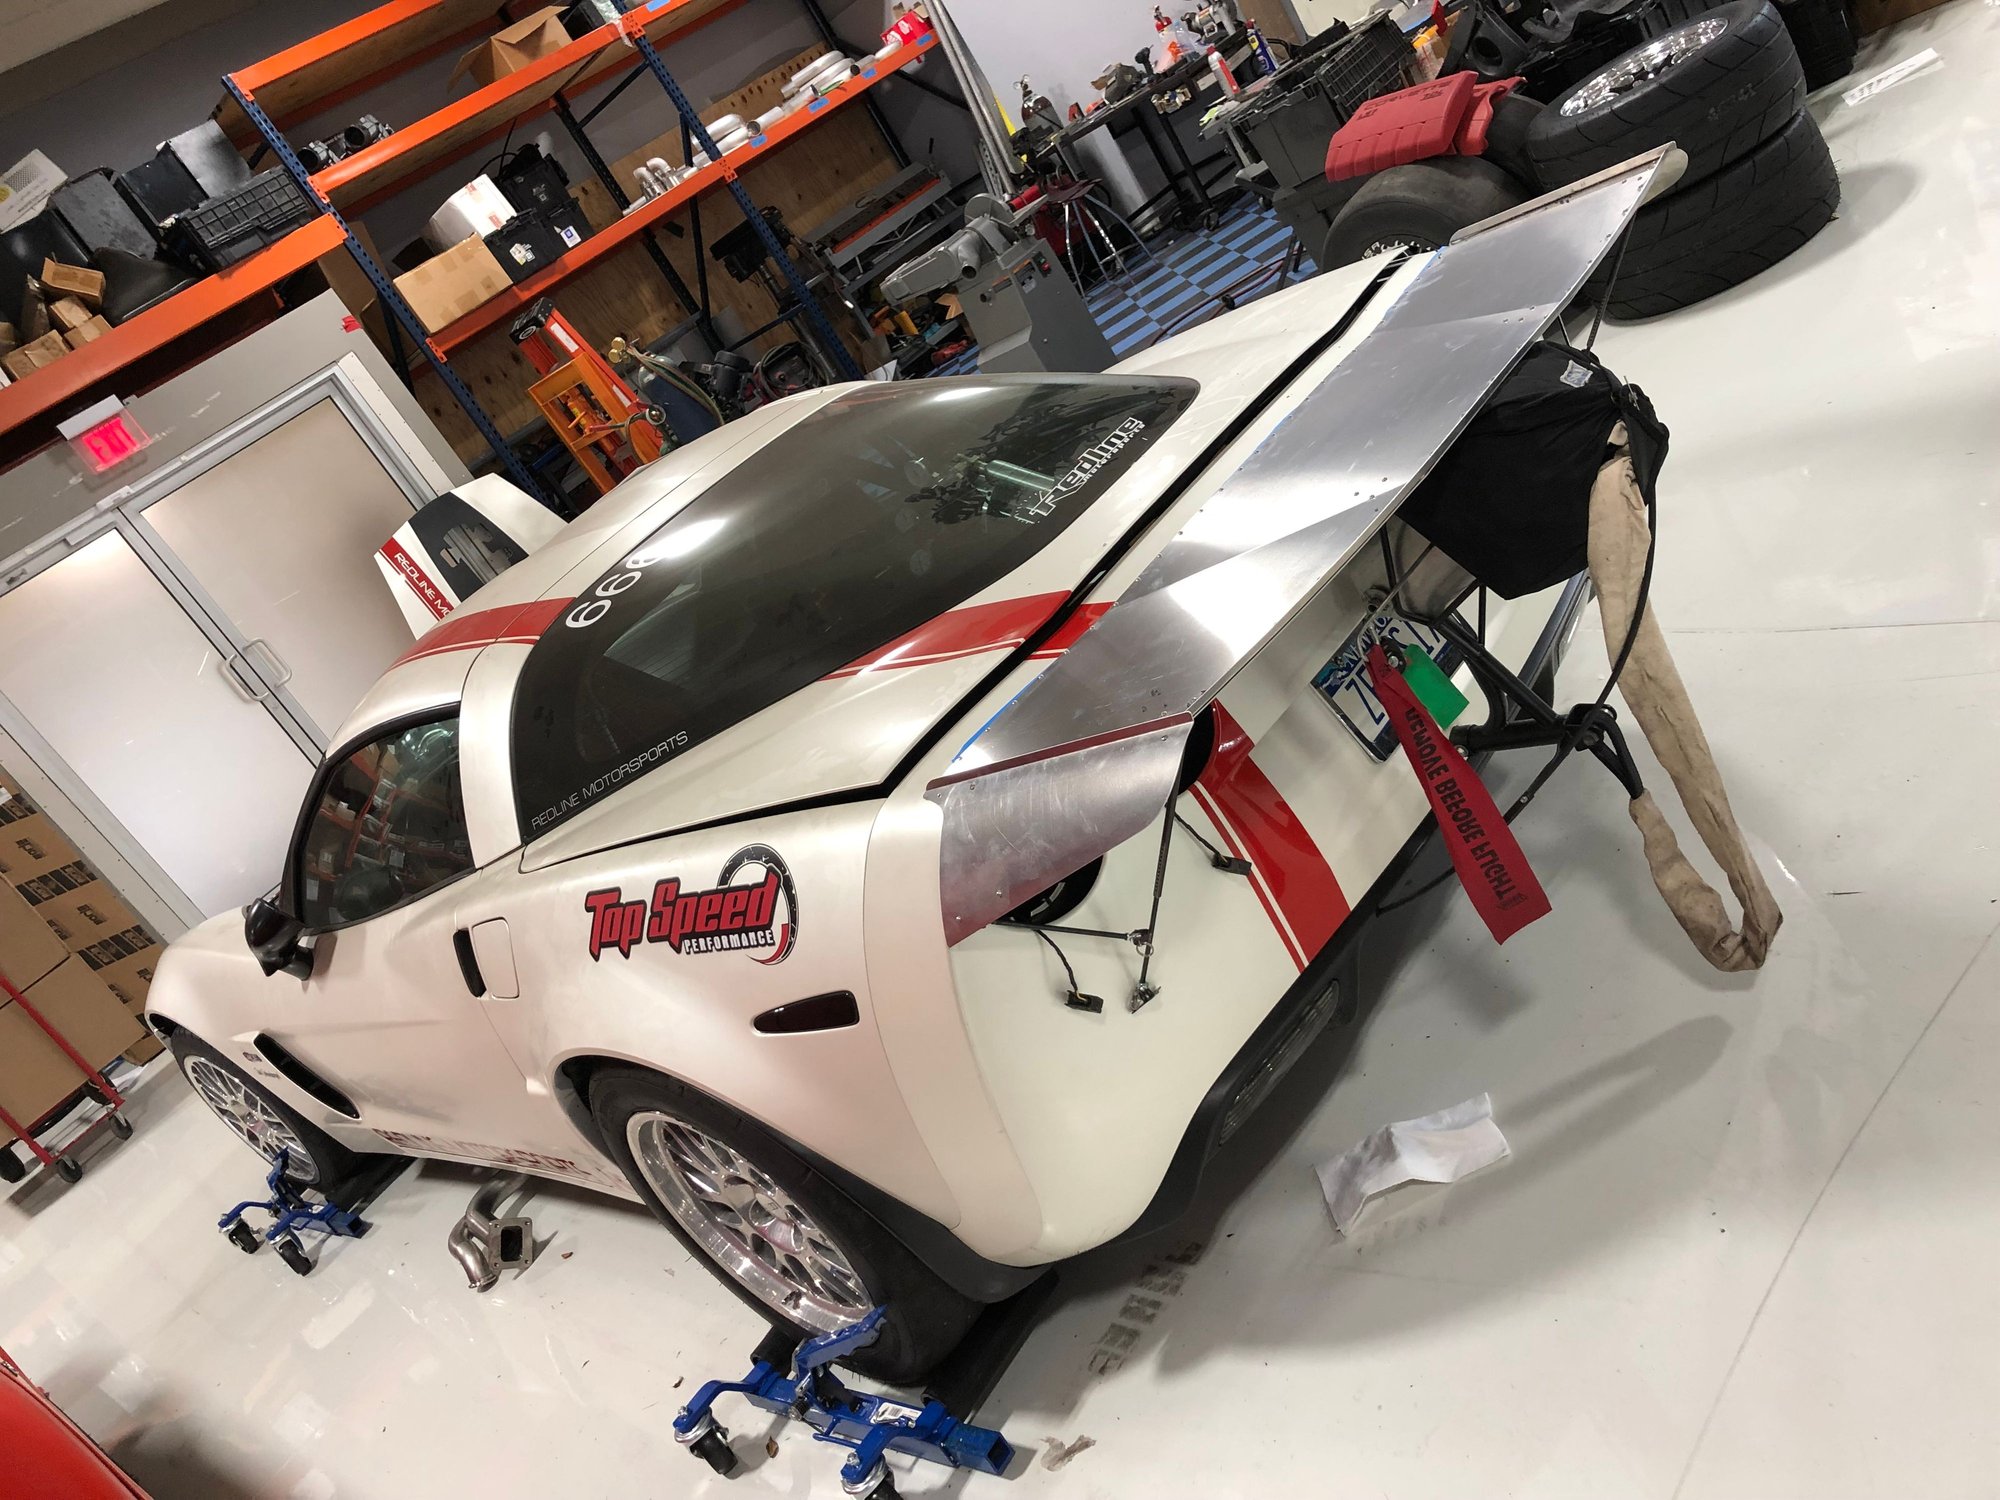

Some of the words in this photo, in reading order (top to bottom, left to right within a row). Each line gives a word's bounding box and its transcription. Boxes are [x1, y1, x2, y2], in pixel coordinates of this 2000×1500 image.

[394, 553, 435, 600] REDLINE
[531, 792, 581, 831] REDLINE
[582, 730, 689, 800] MOTORSPORTS
[682, 929, 775, 954] PERFORMANCE
